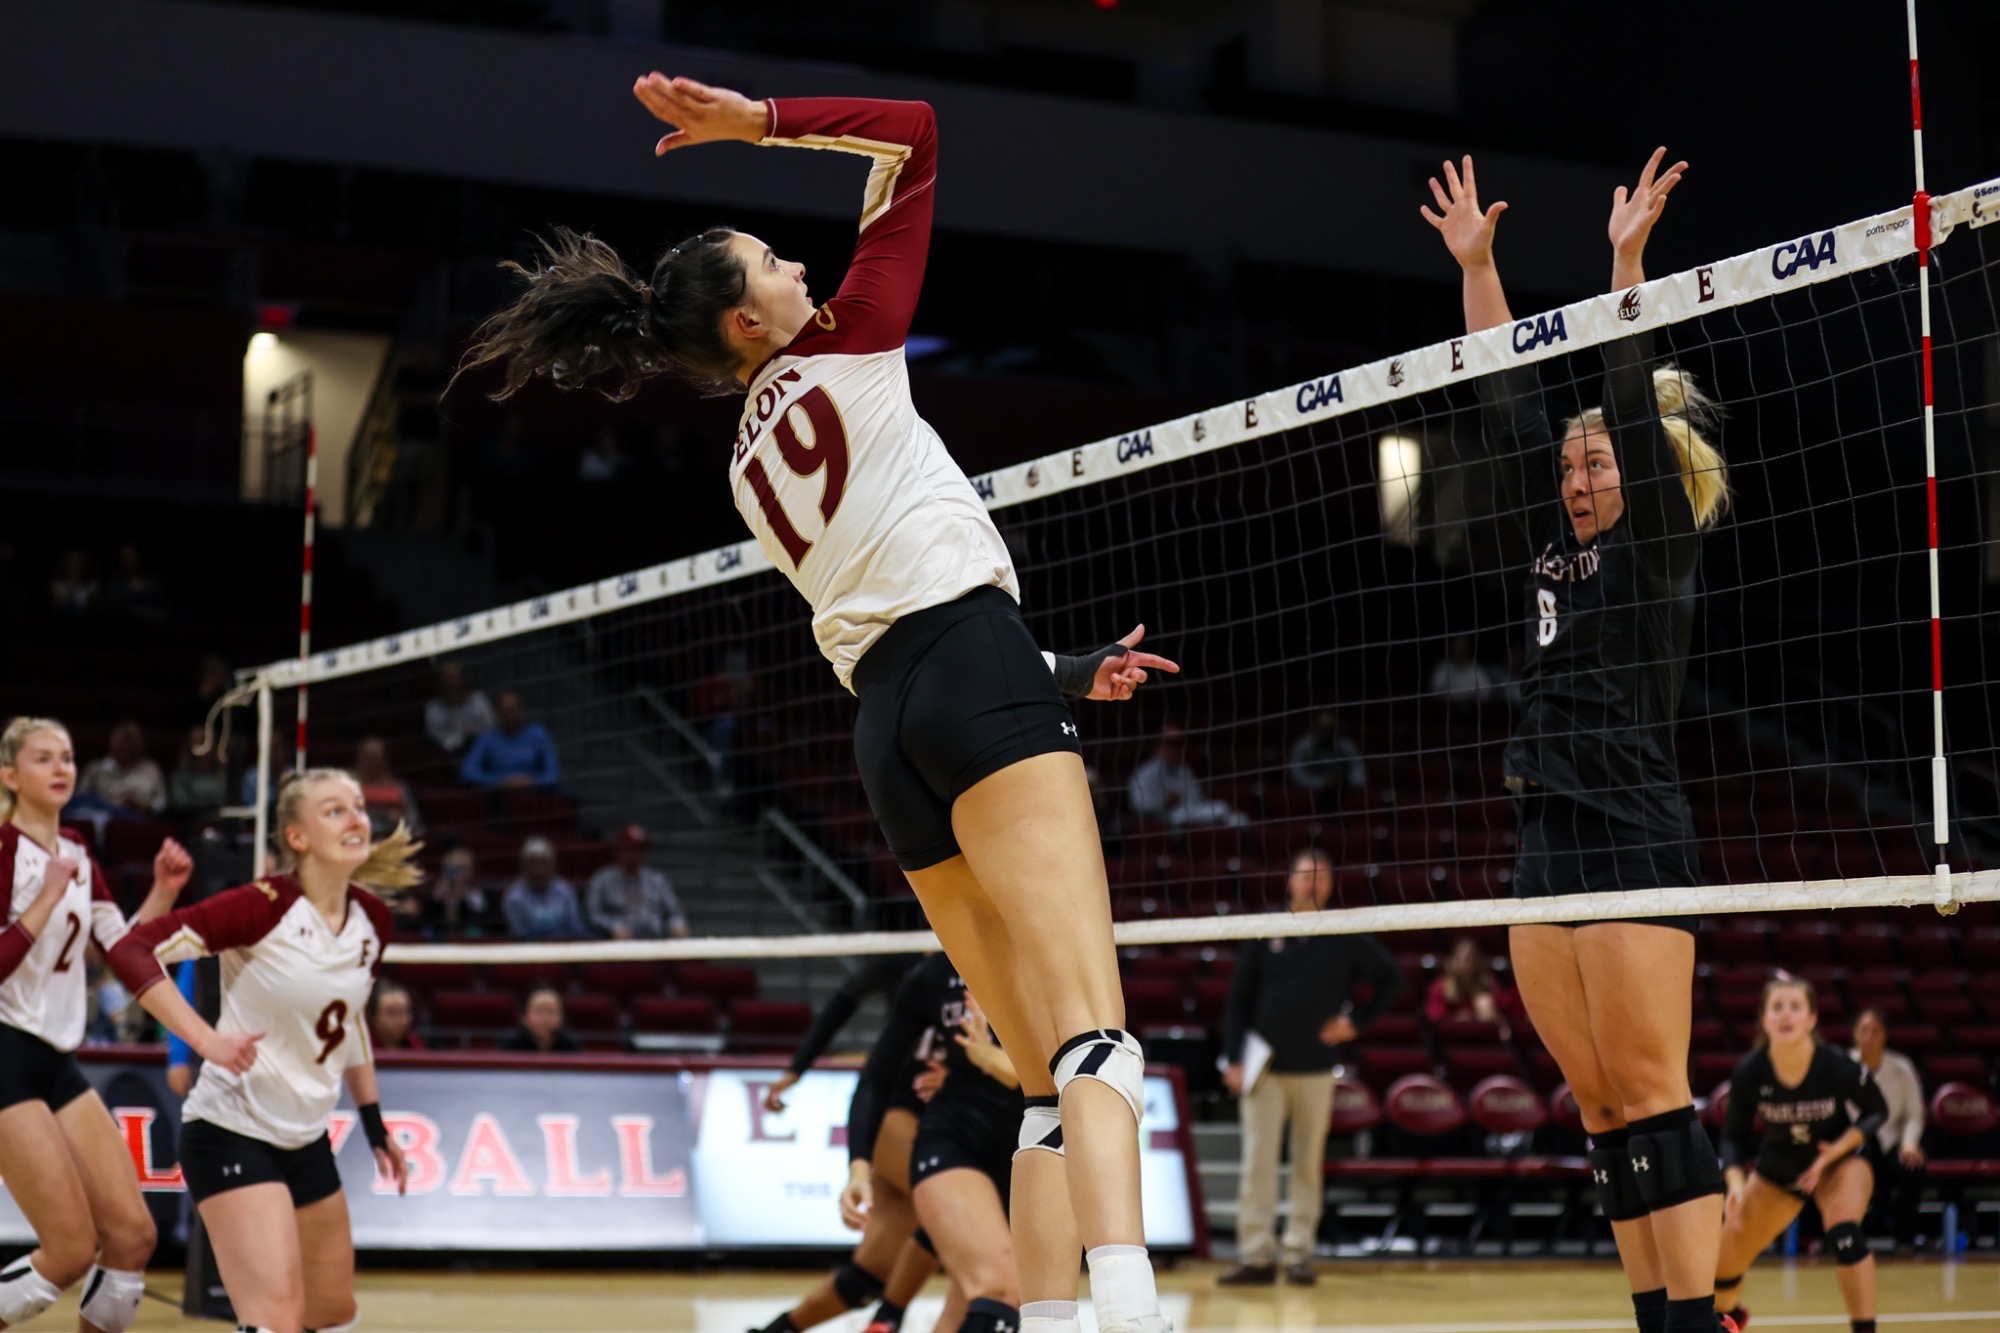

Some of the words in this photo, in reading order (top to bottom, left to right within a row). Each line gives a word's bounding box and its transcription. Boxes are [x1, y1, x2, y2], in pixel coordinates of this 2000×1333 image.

[1771, 231, 1837, 280] CAA
[1697, 265, 1715, 304] E
[1513, 310, 1568, 354] CAA
[1450, 340, 1465, 372] E
[1296, 376, 1344, 413] CAA
[733, 364, 802, 467] ELON
[1245, 400, 1259, 429] E
[1072, 450, 1085, 478] E
[1117, 430, 1154, 464] CAA
[742, 383, 851, 573] 19
[969, 474, 996, 501] AA
[52, 911, 81, 973] 2
[314, 1000, 348, 1065] 9
